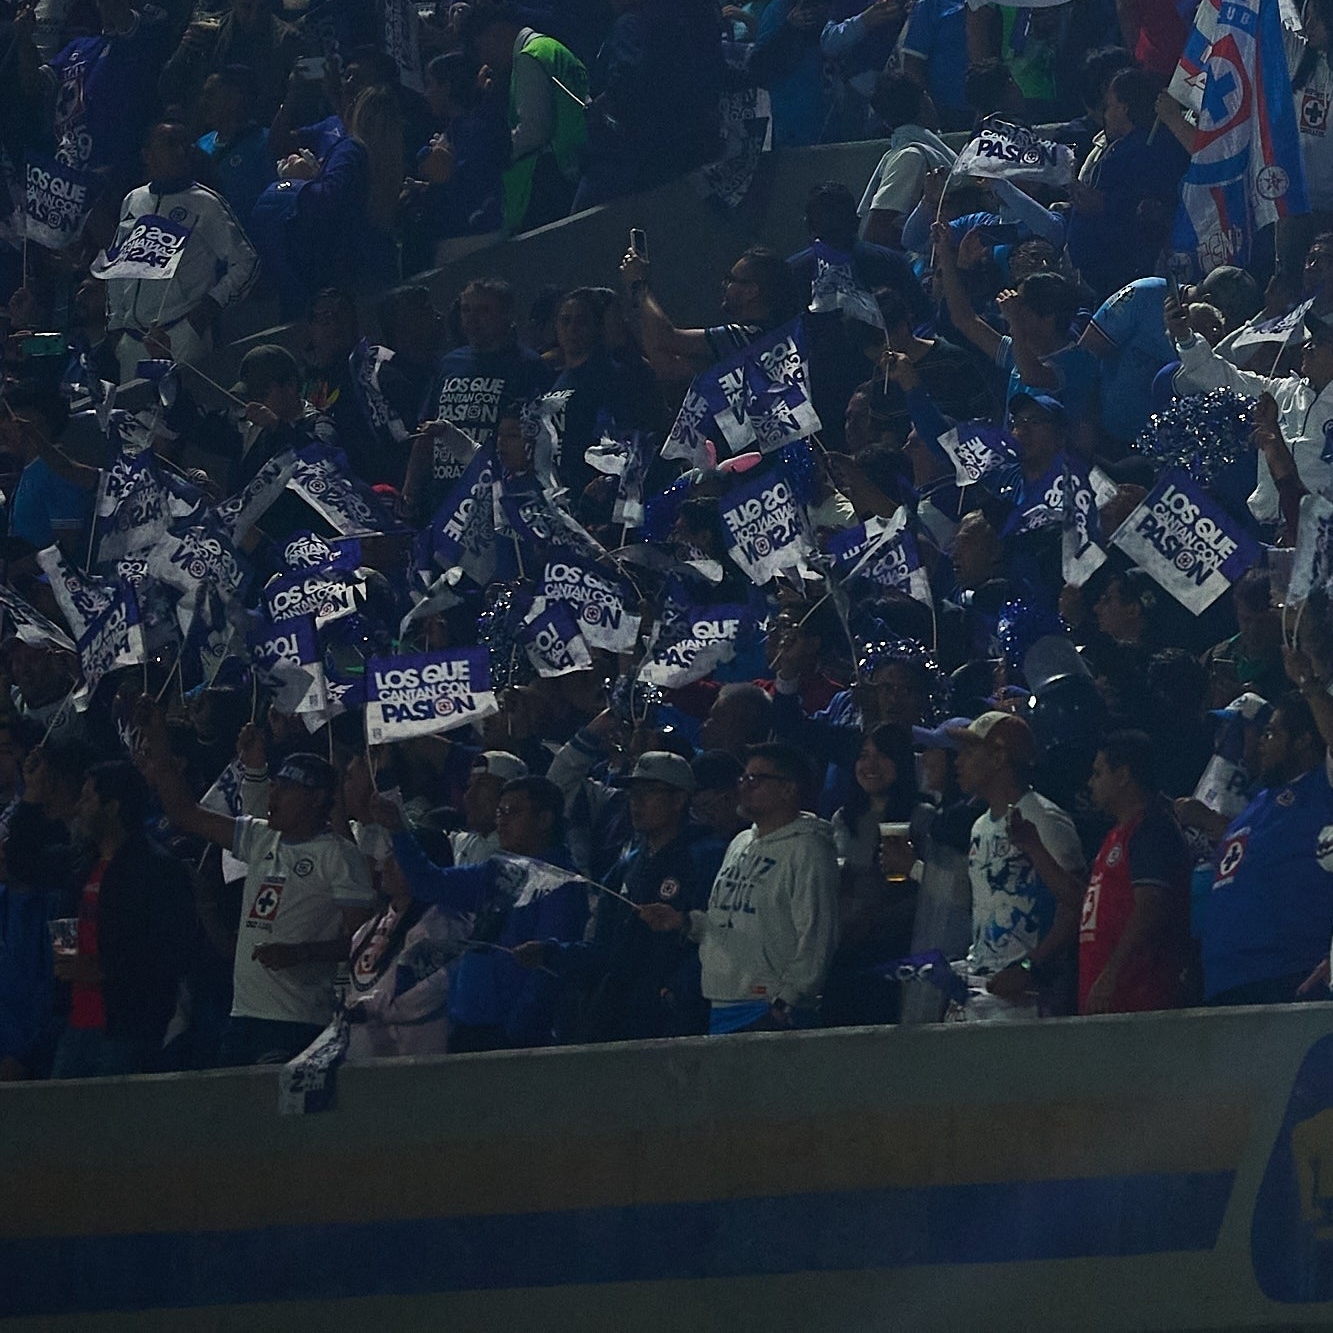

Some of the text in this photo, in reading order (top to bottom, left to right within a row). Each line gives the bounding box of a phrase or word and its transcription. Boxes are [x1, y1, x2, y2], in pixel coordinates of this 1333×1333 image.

[443, 377, 505, 394] LOS QUE
[475, 393, 500, 404] CON
[1161, 485, 1238, 560] LOS QUE
[1152, 503, 1224, 567] CANTAN CON
[544, 562, 582, 585] LOS
[269, 585, 303, 615] LOS
[692, 619, 740, 640] QUE
[375, 660, 470, 691] LOS QUE
[378, 681, 471, 703] CANTAN CON
